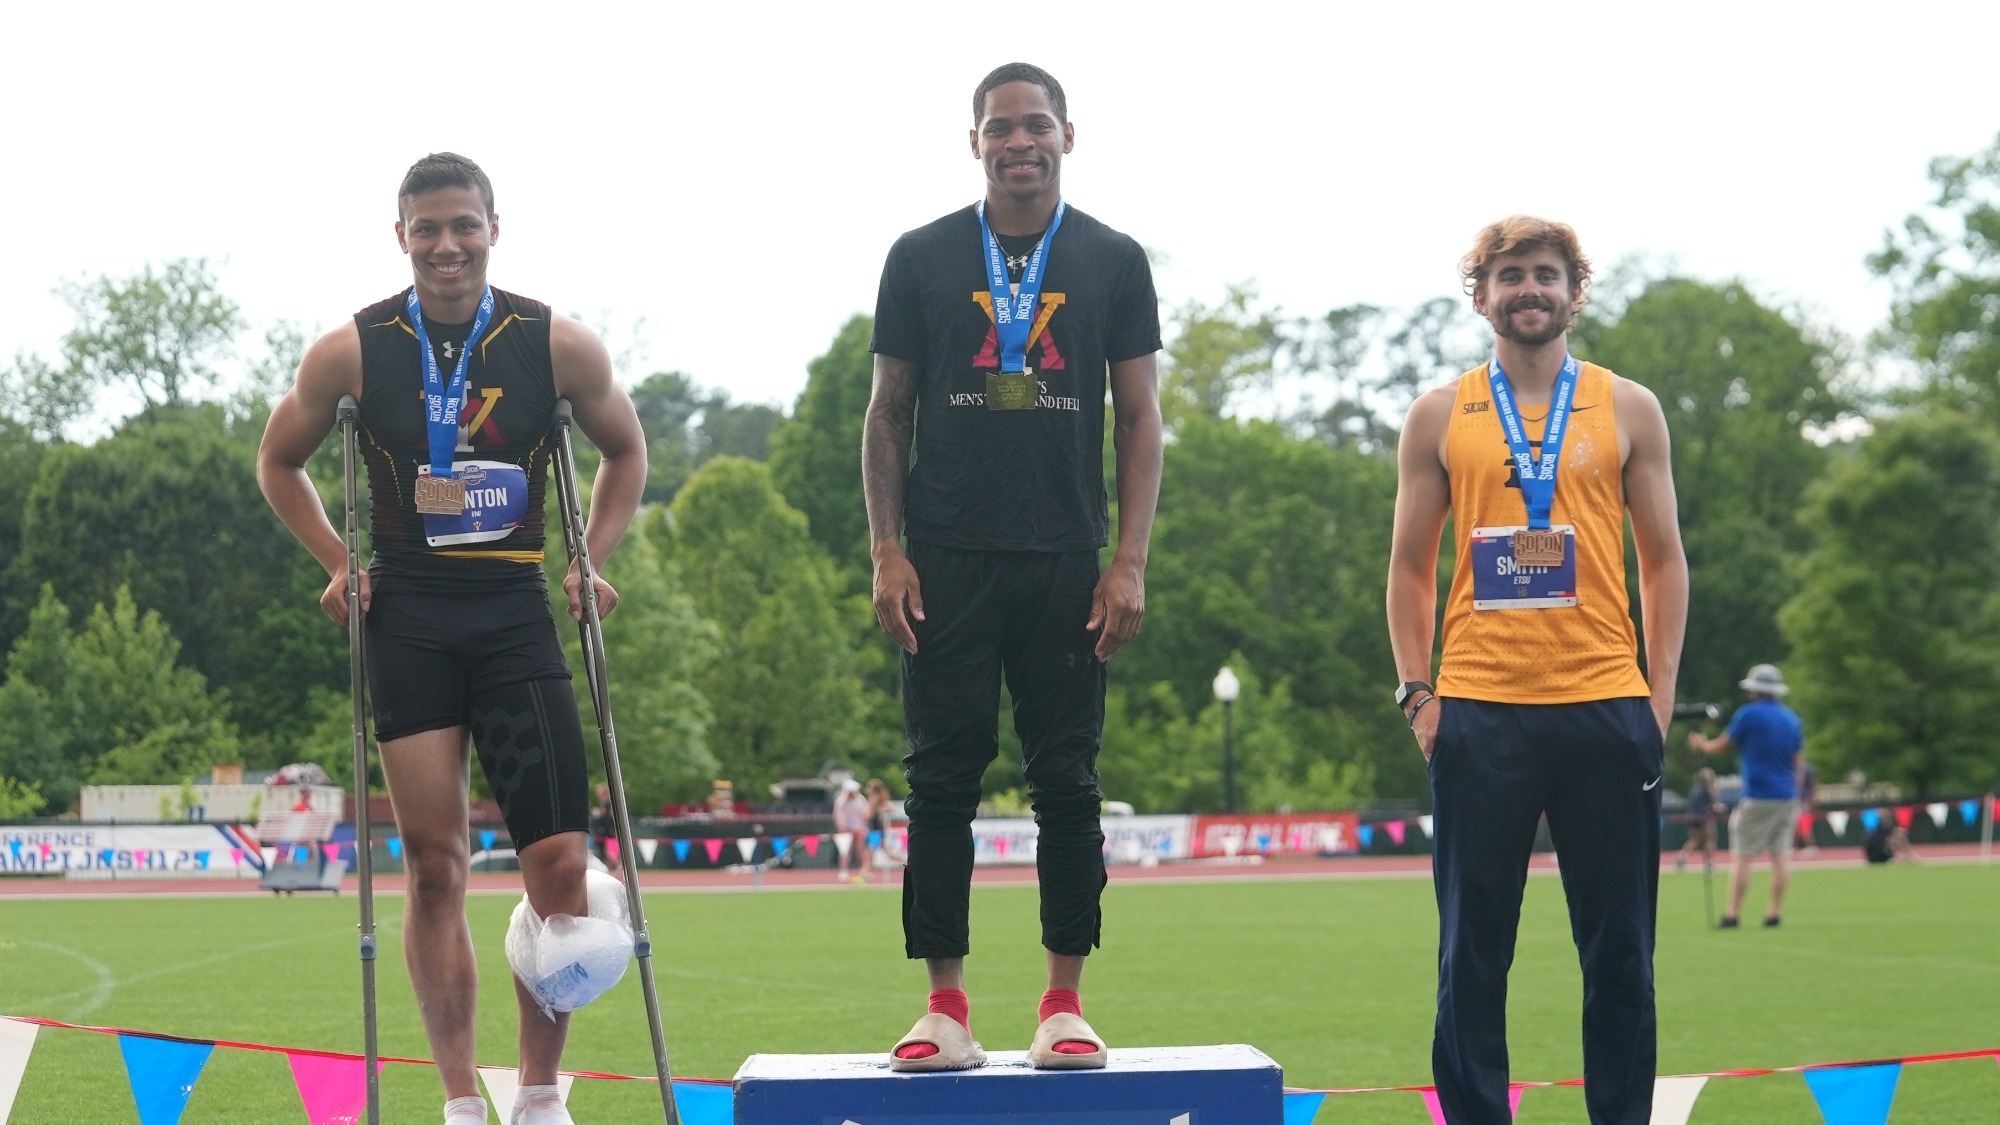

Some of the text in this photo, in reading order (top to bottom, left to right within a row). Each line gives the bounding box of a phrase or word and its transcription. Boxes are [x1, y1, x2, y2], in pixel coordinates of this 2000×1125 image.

[990, 247, 1002, 276] SOUTHERN
[994, 276, 1003, 287] THE
[949, 393, 984, 407] MEN'S
[1513, 575, 1532, 585] ETSU
